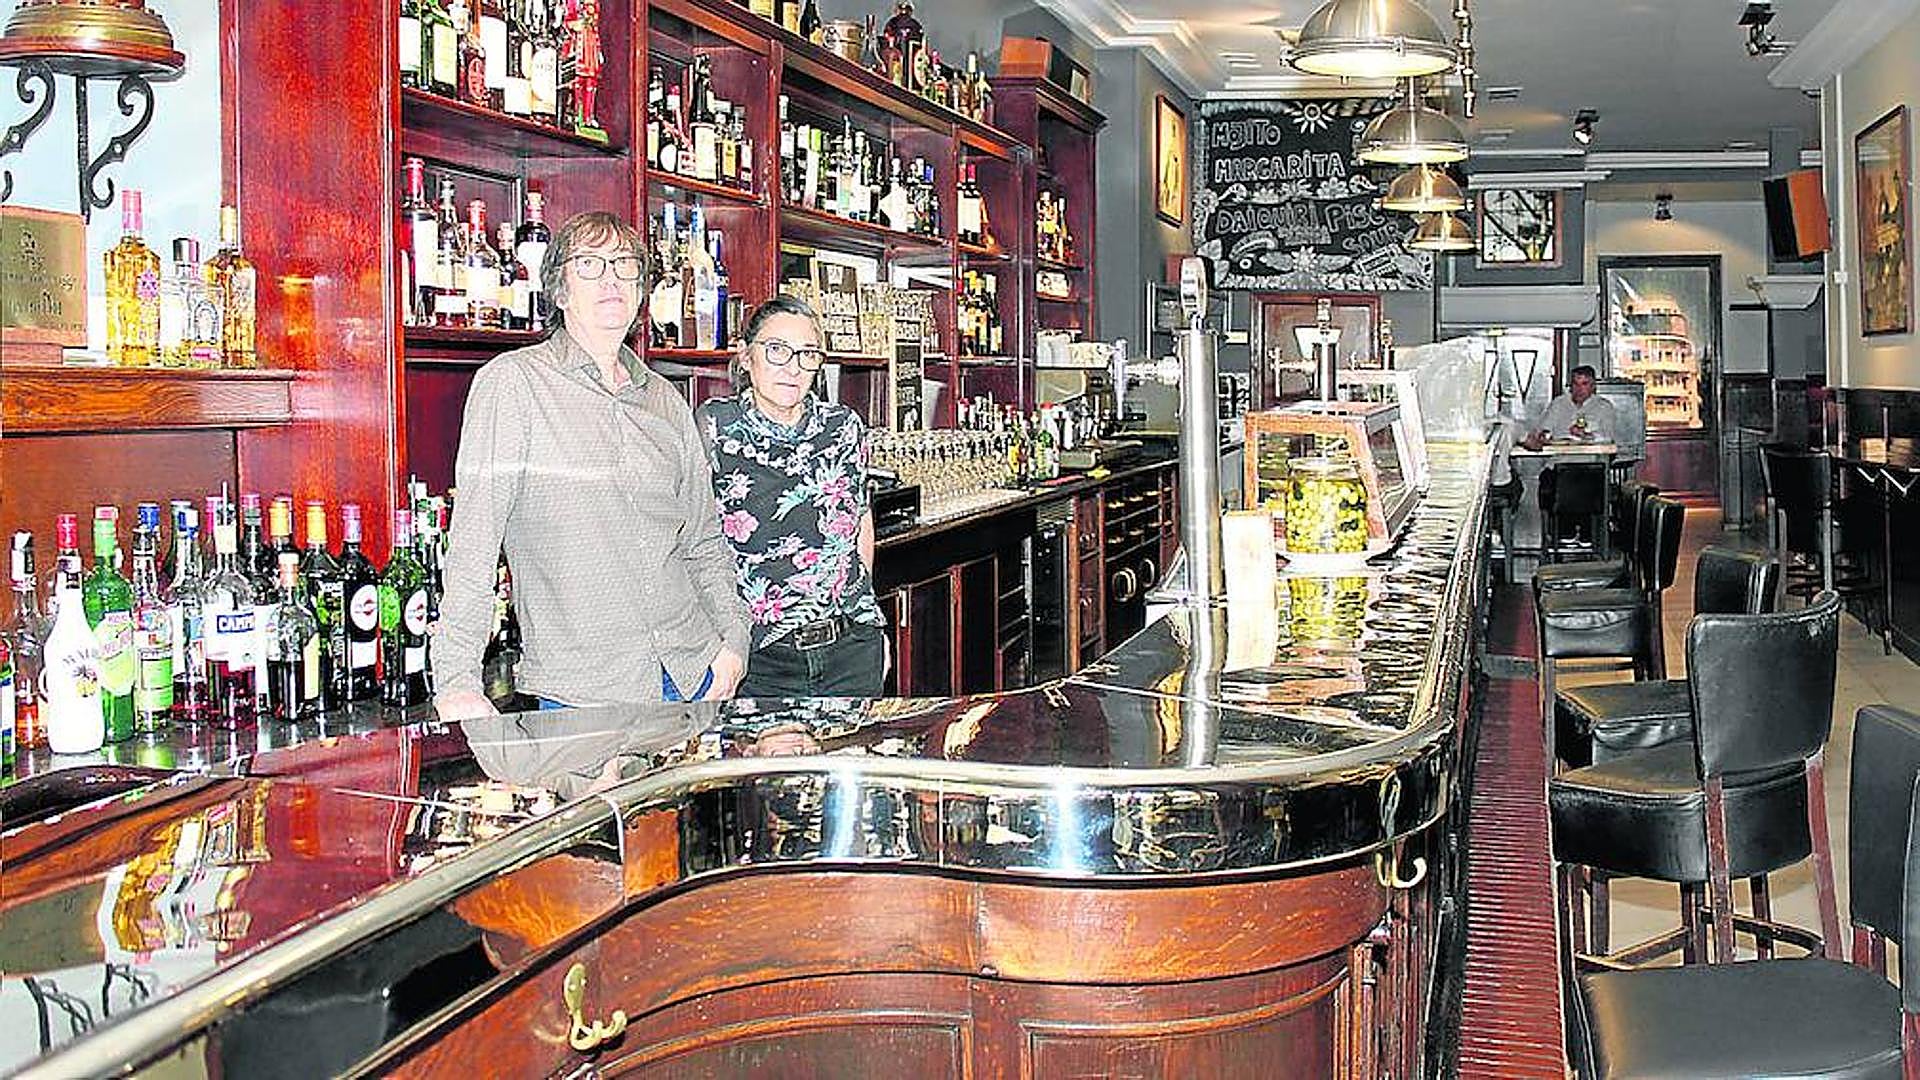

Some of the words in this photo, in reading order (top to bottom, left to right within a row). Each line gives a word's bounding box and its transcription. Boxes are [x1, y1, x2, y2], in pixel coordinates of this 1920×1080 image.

[1211, 119, 1281, 150] MOJITO
[1215, 150, 1346, 183] MARGARITA
[1215, 202, 1320, 234] DAIQUIRI
[1325, 203, 1386, 233] PISC
[1342, 222, 1402, 257] SOUR
